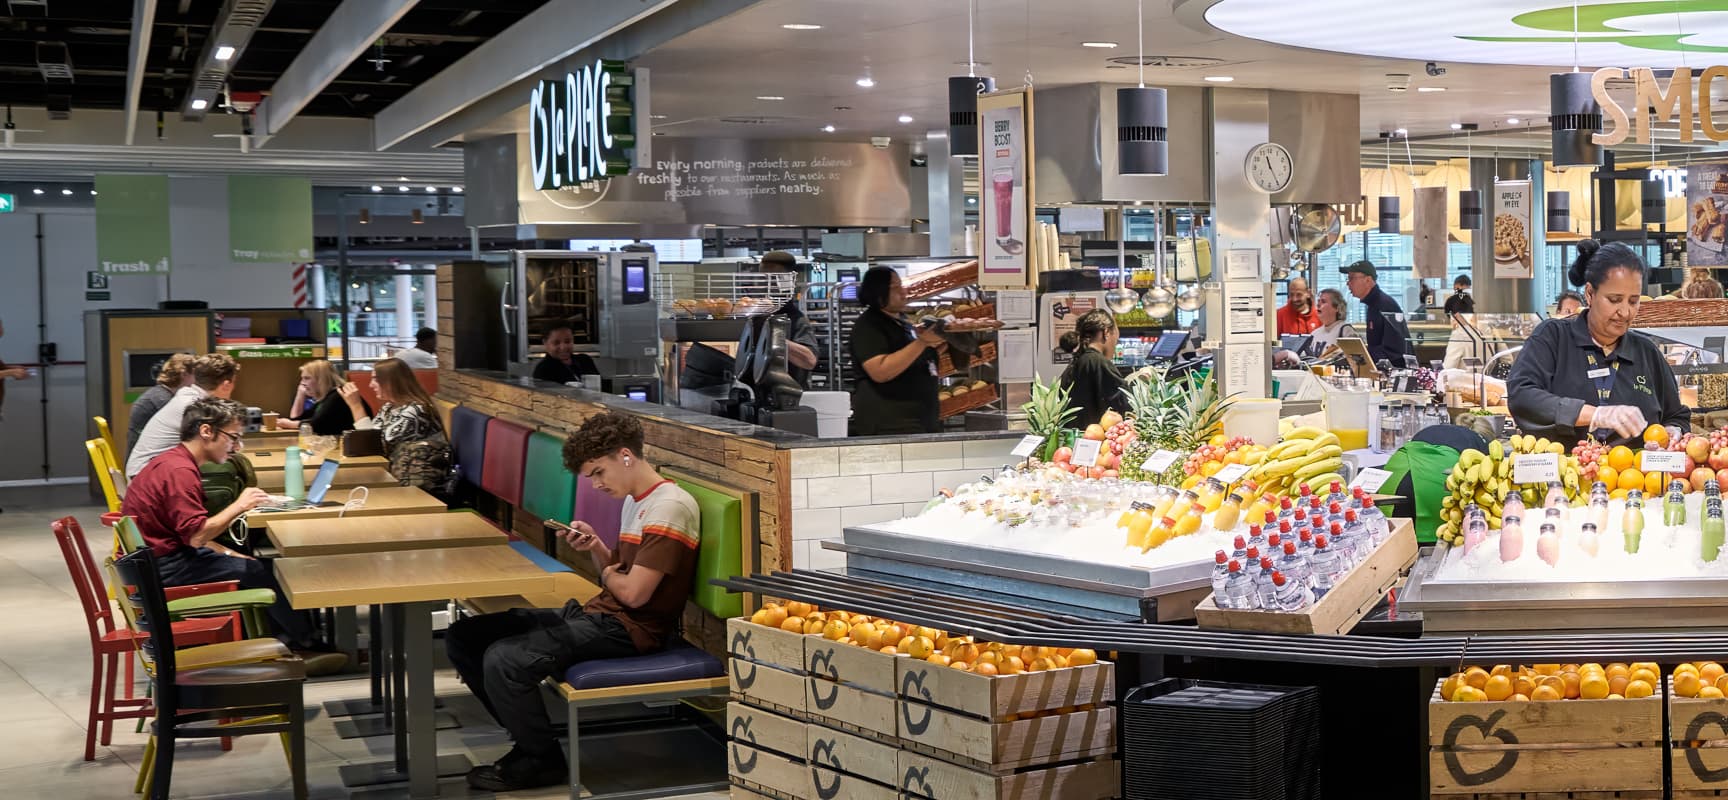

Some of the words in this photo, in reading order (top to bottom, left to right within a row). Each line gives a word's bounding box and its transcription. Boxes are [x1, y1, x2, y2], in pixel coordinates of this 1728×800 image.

[566, 59, 613, 183] PLACE
[994, 120, 1010, 132] BERRY
[994, 133, 1011, 146] BOOST
[656, 160, 690, 173] Every
[637, 171, 682, 186] freshly
[687, 174, 697, 183] to
[784, 171, 796, 181] As
[706, 185, 729, 197] from
[1502, 192, 1515, 200] APPLE
[102, 260, 150, 273] Trash
